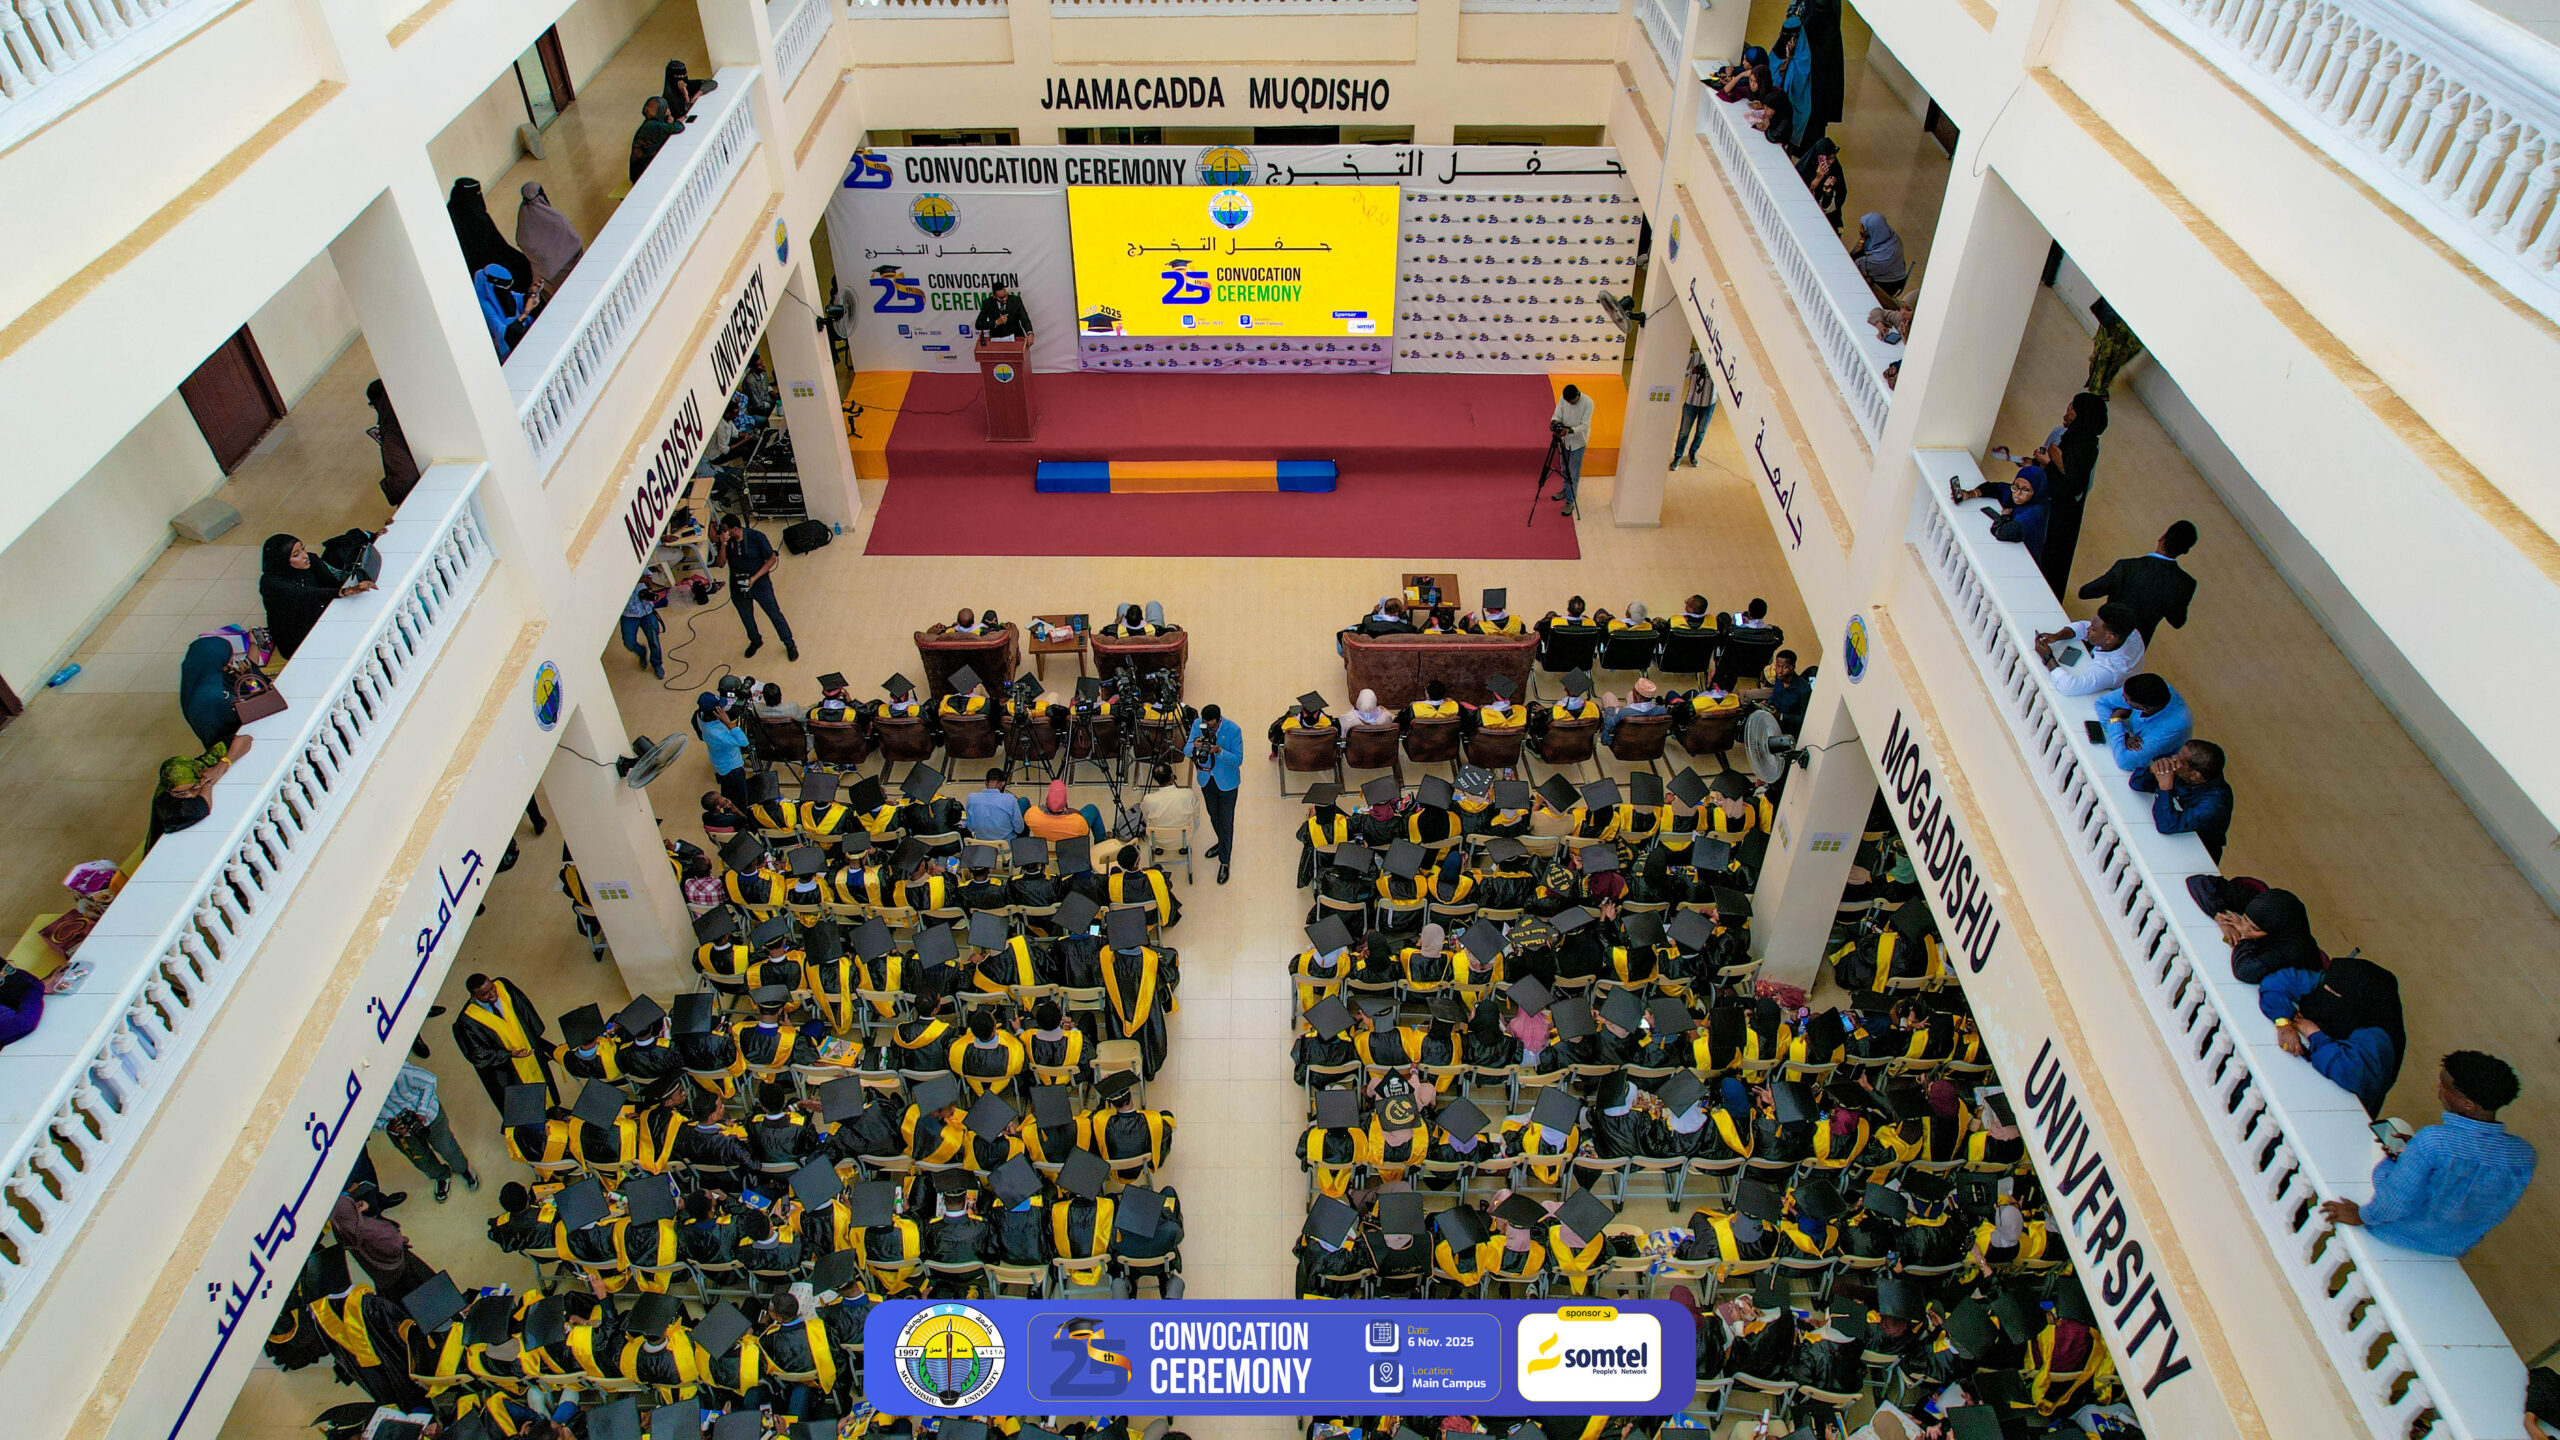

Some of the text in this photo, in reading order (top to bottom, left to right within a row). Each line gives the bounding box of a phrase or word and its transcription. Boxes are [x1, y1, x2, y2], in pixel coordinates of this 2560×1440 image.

[1040, 76, 1390, 113] JAAMACADDA MUQDISHO
[905, 157, 1059, 184] CONVOCATION
[1064, 158, 1187, 185] CEREMONY
[1127, 236, 1333, 257] حفل التخرج
[1161, 271, 1211, 304] 25
[1216, 267, 1301, 282] CONVOCATION
[869, 278, 924, 313] 25
[1217, 285, 1302, 302] CEREMONY
[1100, 304, 1122, 319] 2025
[623, 263, 768, 564] MOGADISHU UNIVERSITY
[1881, 708, 2001, 976] MOGADISHU
